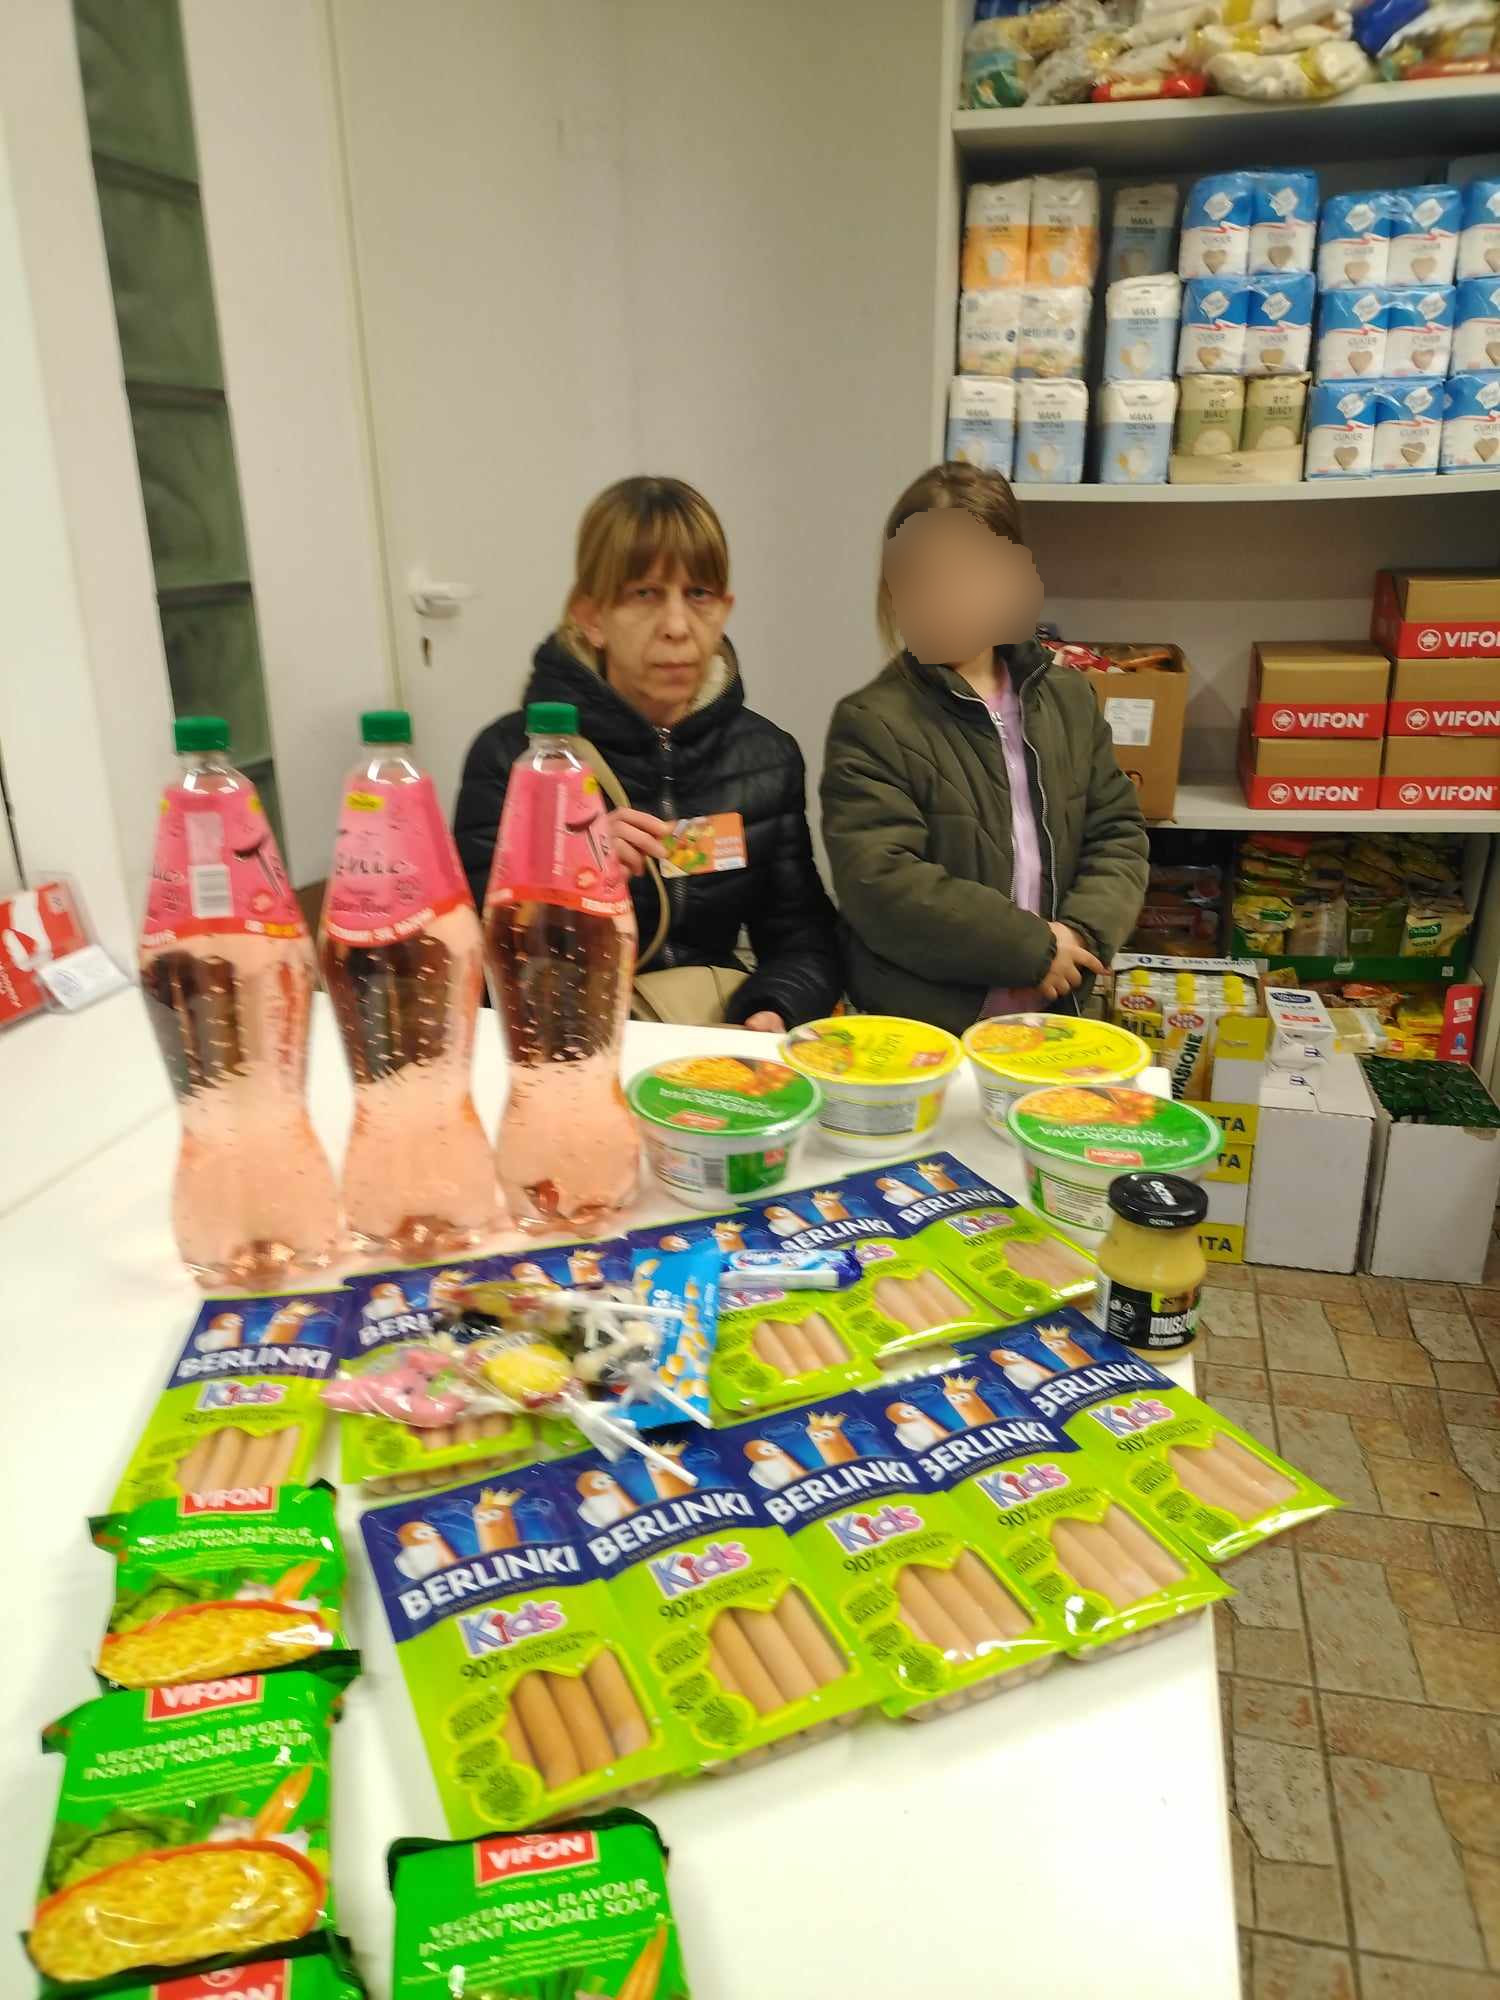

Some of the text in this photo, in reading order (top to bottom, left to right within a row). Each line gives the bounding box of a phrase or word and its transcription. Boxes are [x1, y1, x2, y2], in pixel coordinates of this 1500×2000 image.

[1297, 712, 1365, 729] VIFON
[1433, 710, 1500, 727] VIFON
[1293, 785, 1360, 802] VIFON
[1425, 785, 1493, 801] VIFON
[898, 1190, 1008, 1226] BERLINKI
[177, 1346, 333, 1379] BERLINKI
[1030, 1363, 1152, 1419] BERLINKI
[1089, 1398, 1175, 1438] Kids
[917, 1421, 1059, 1483] BERLINKI
[763, 1460, 920, 1526] BERLINKI
[975, 1463, 1070, 1509] Kids
[587, 1492, 756, 1567] BERLINKI
[825, 1505, 925, 1556] Kids
[397, 1544, 582, 1621] BERLINKI
[648, 1542, 752, 1600] Kids
[457, 1602, 567, 1658] Kids
[160, 1677, 253, 1708] VIFON
[487, 1835, 587, 1871] VIFON
[509, 1902, 598, 1934] NOODLE
[602, 1890, 662, 1917] SOUP
[557, 1878, 650, 1908] FLAVOUR
